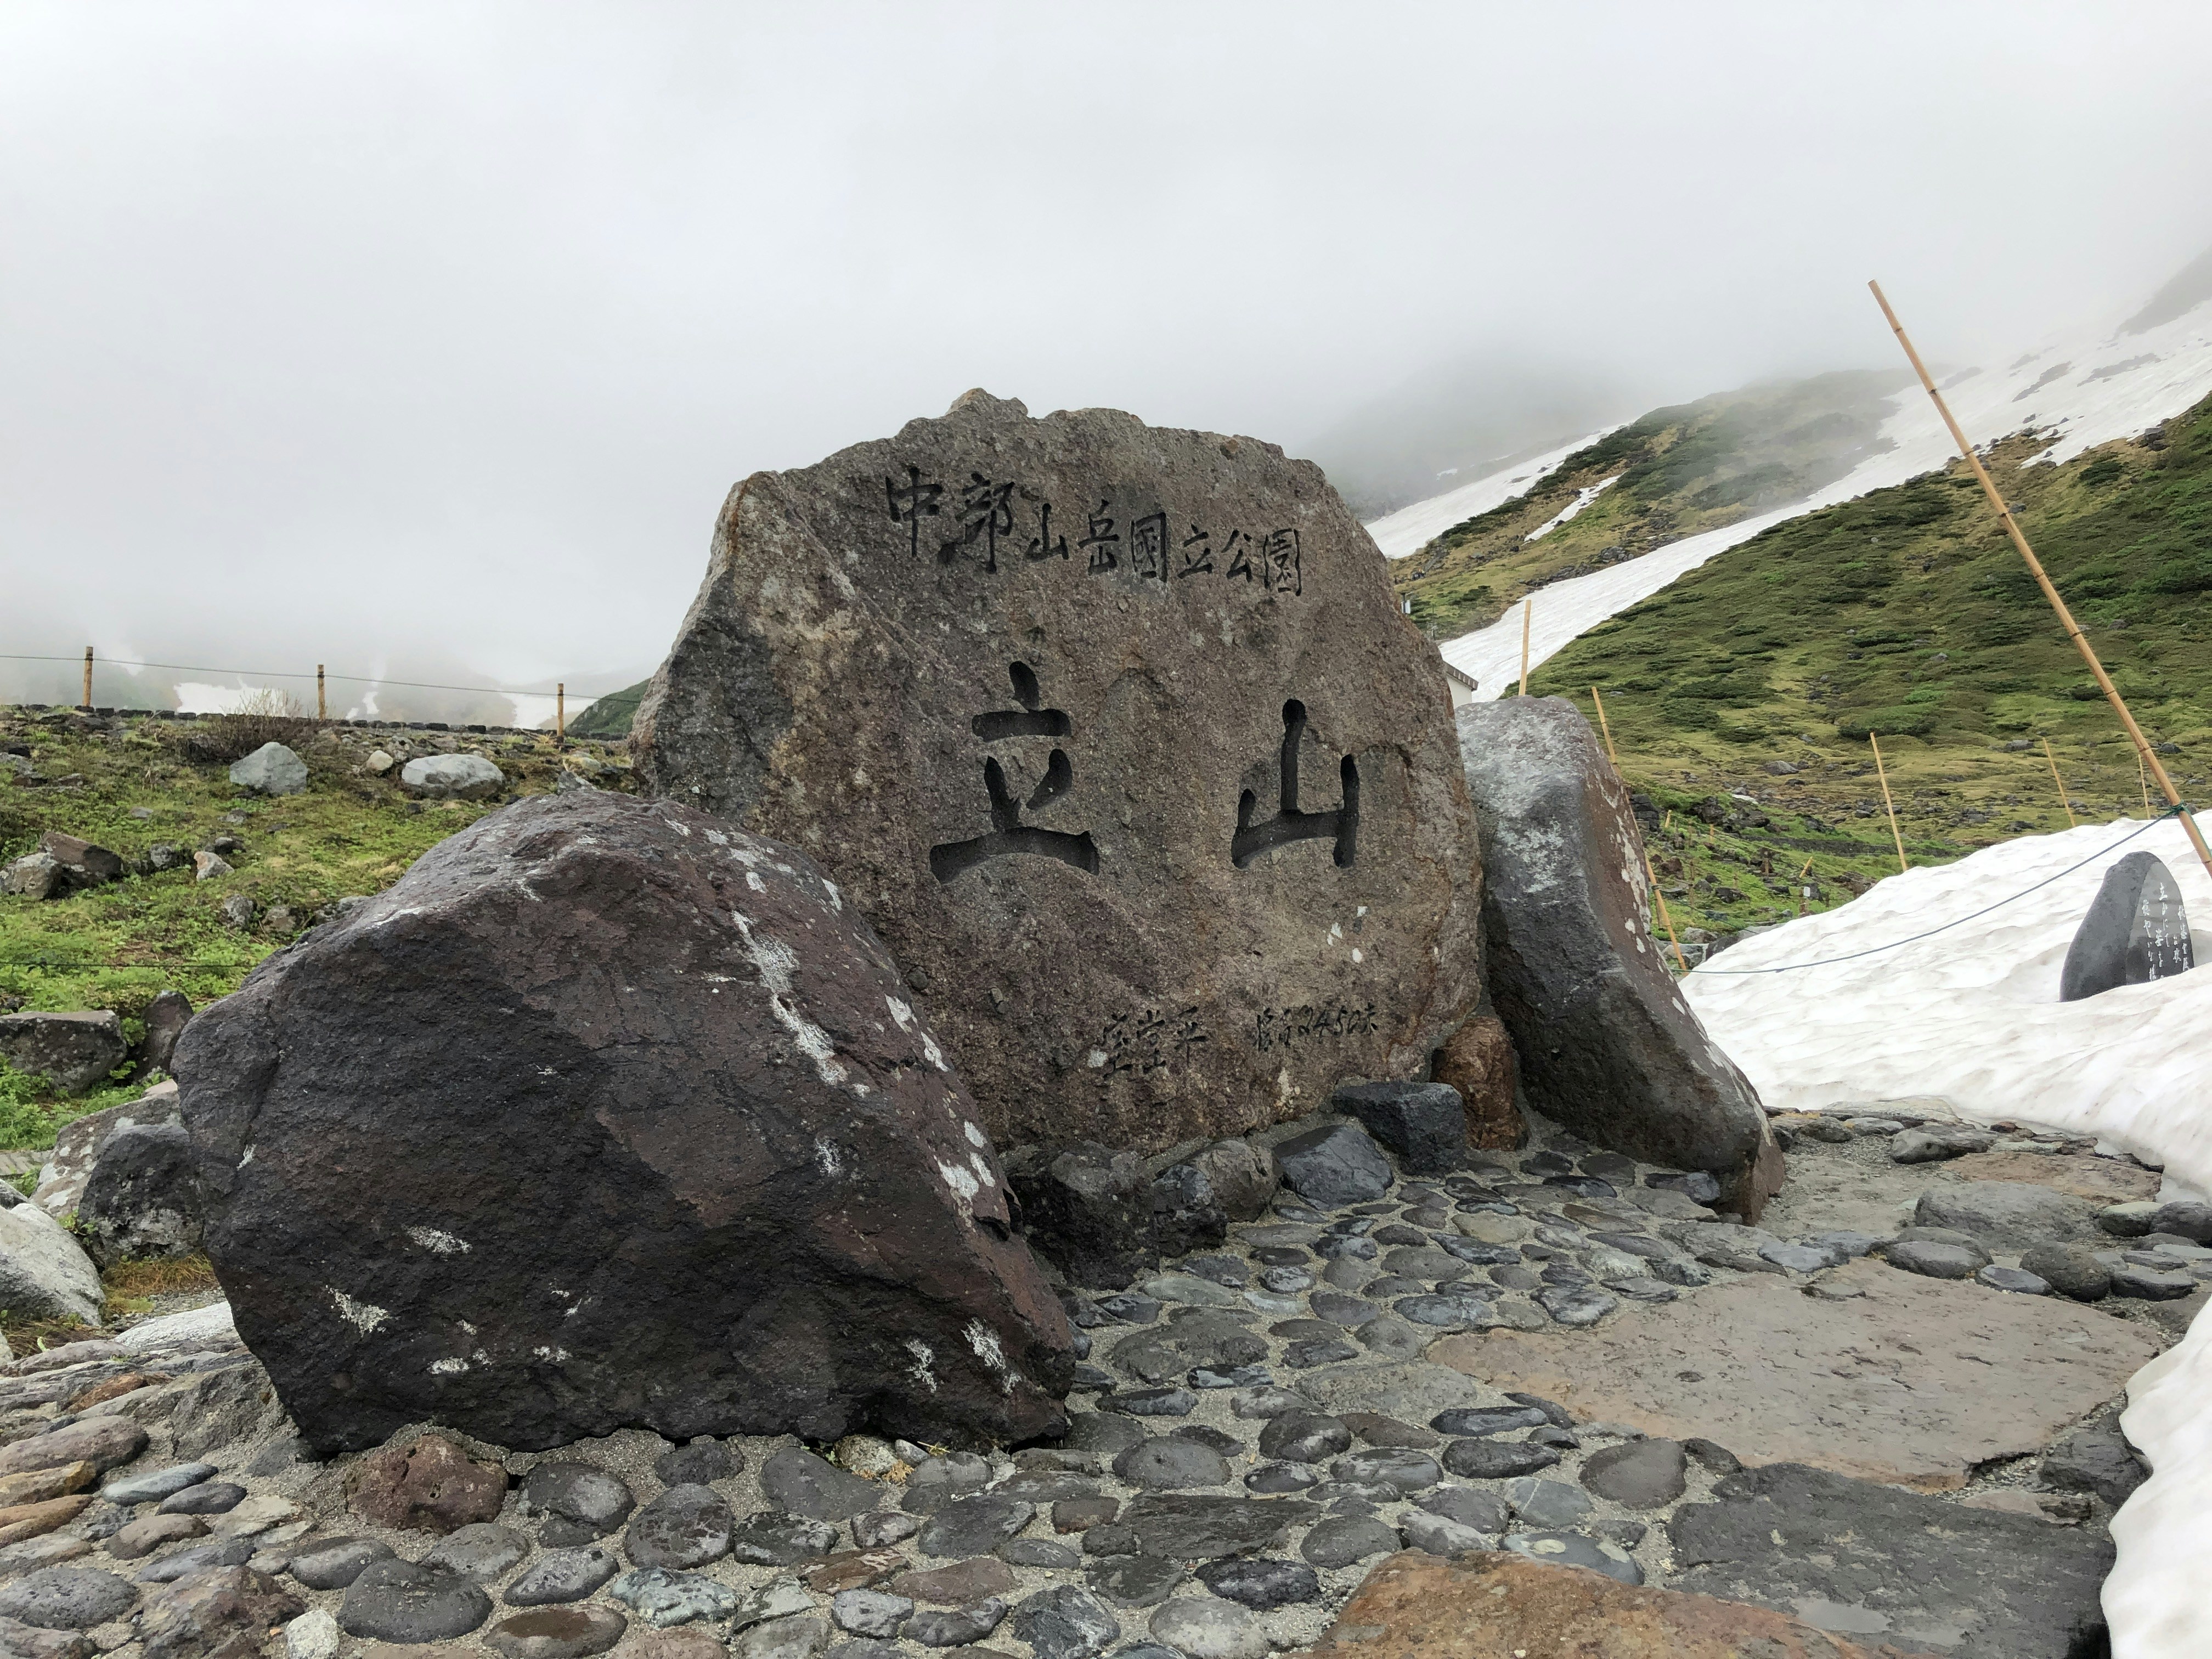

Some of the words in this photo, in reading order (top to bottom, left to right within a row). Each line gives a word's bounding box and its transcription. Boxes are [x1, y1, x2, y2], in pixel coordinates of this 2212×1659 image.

[929, 661, 1361, 884] 立山
[1102, 1006, 1207, 1080] 室堂平
